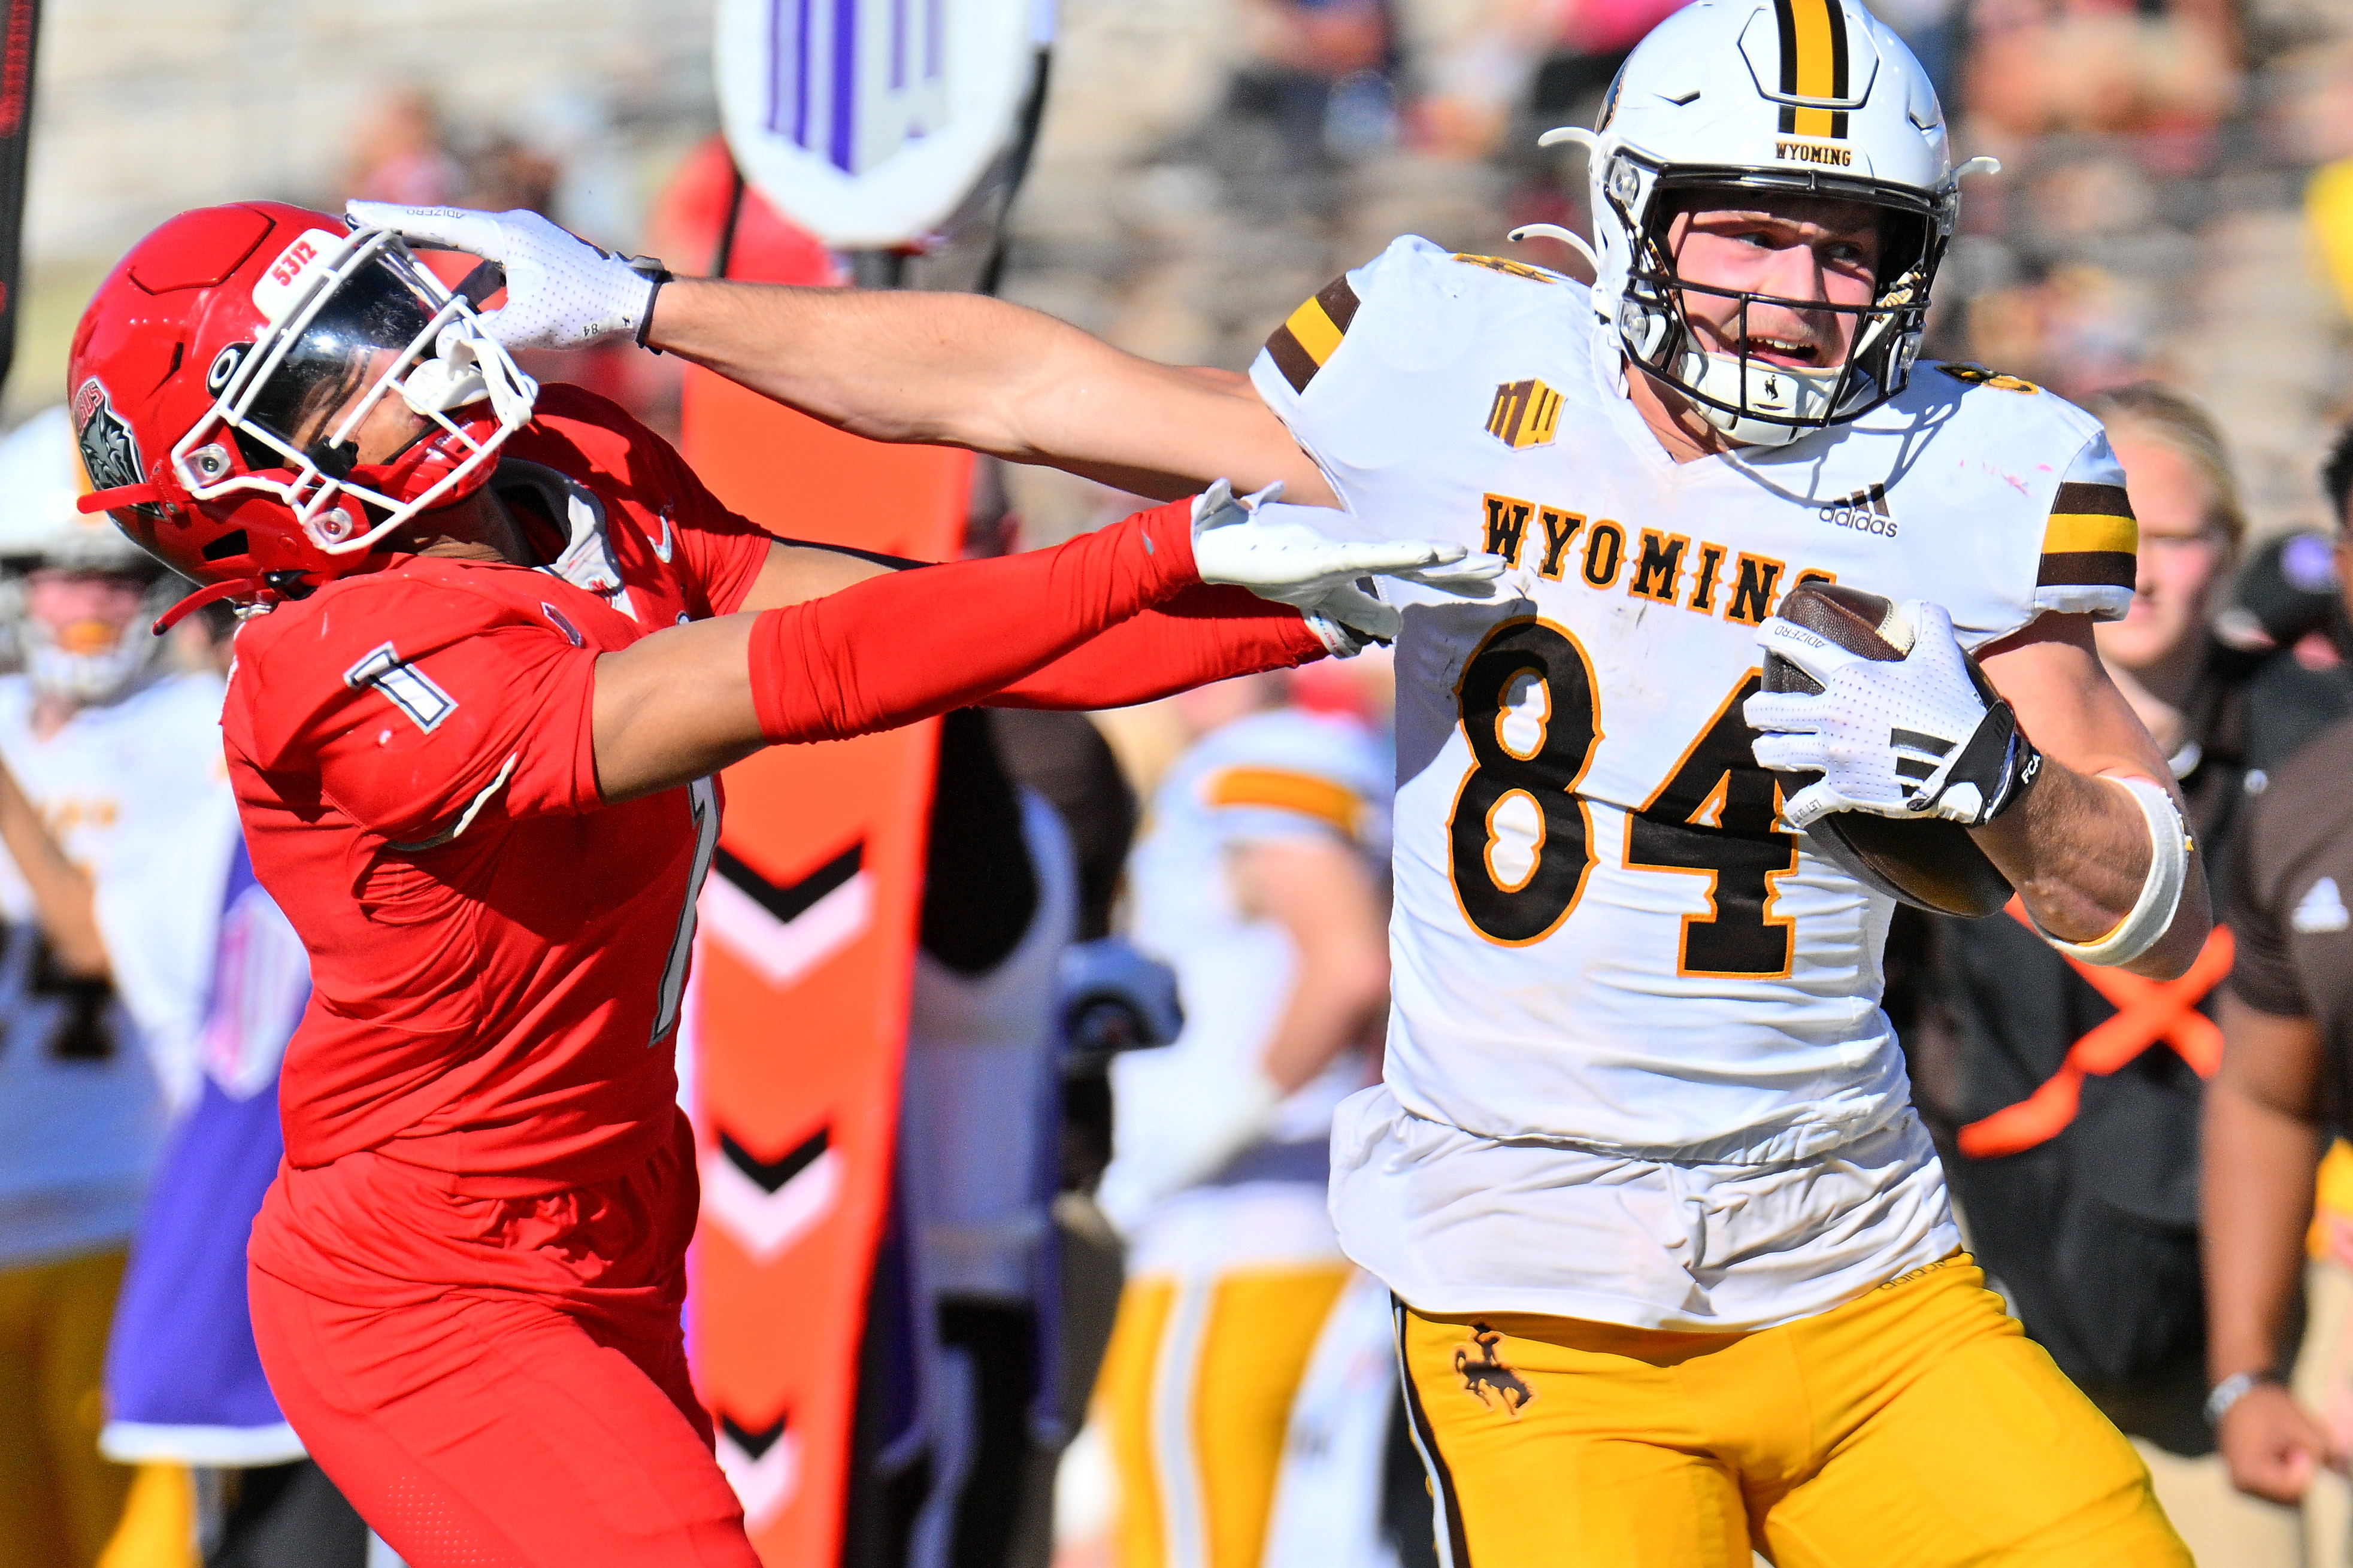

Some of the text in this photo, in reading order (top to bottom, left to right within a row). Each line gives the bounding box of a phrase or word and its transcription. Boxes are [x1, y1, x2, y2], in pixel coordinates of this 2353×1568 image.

[1774, 141, 1851, 167] WYOMING
[407, 208, 465, 219] ADIZERO
[272, 241, 317, 286] 5312
[583, 323, 598, 337] 84
[1819, 507, 1898, 537] adidas
[1482, 492, 1837, 629] WYOMIN
[1774, 625, 1828, 648] ADIZERO
[1446, 615, 1797, 979] 84
